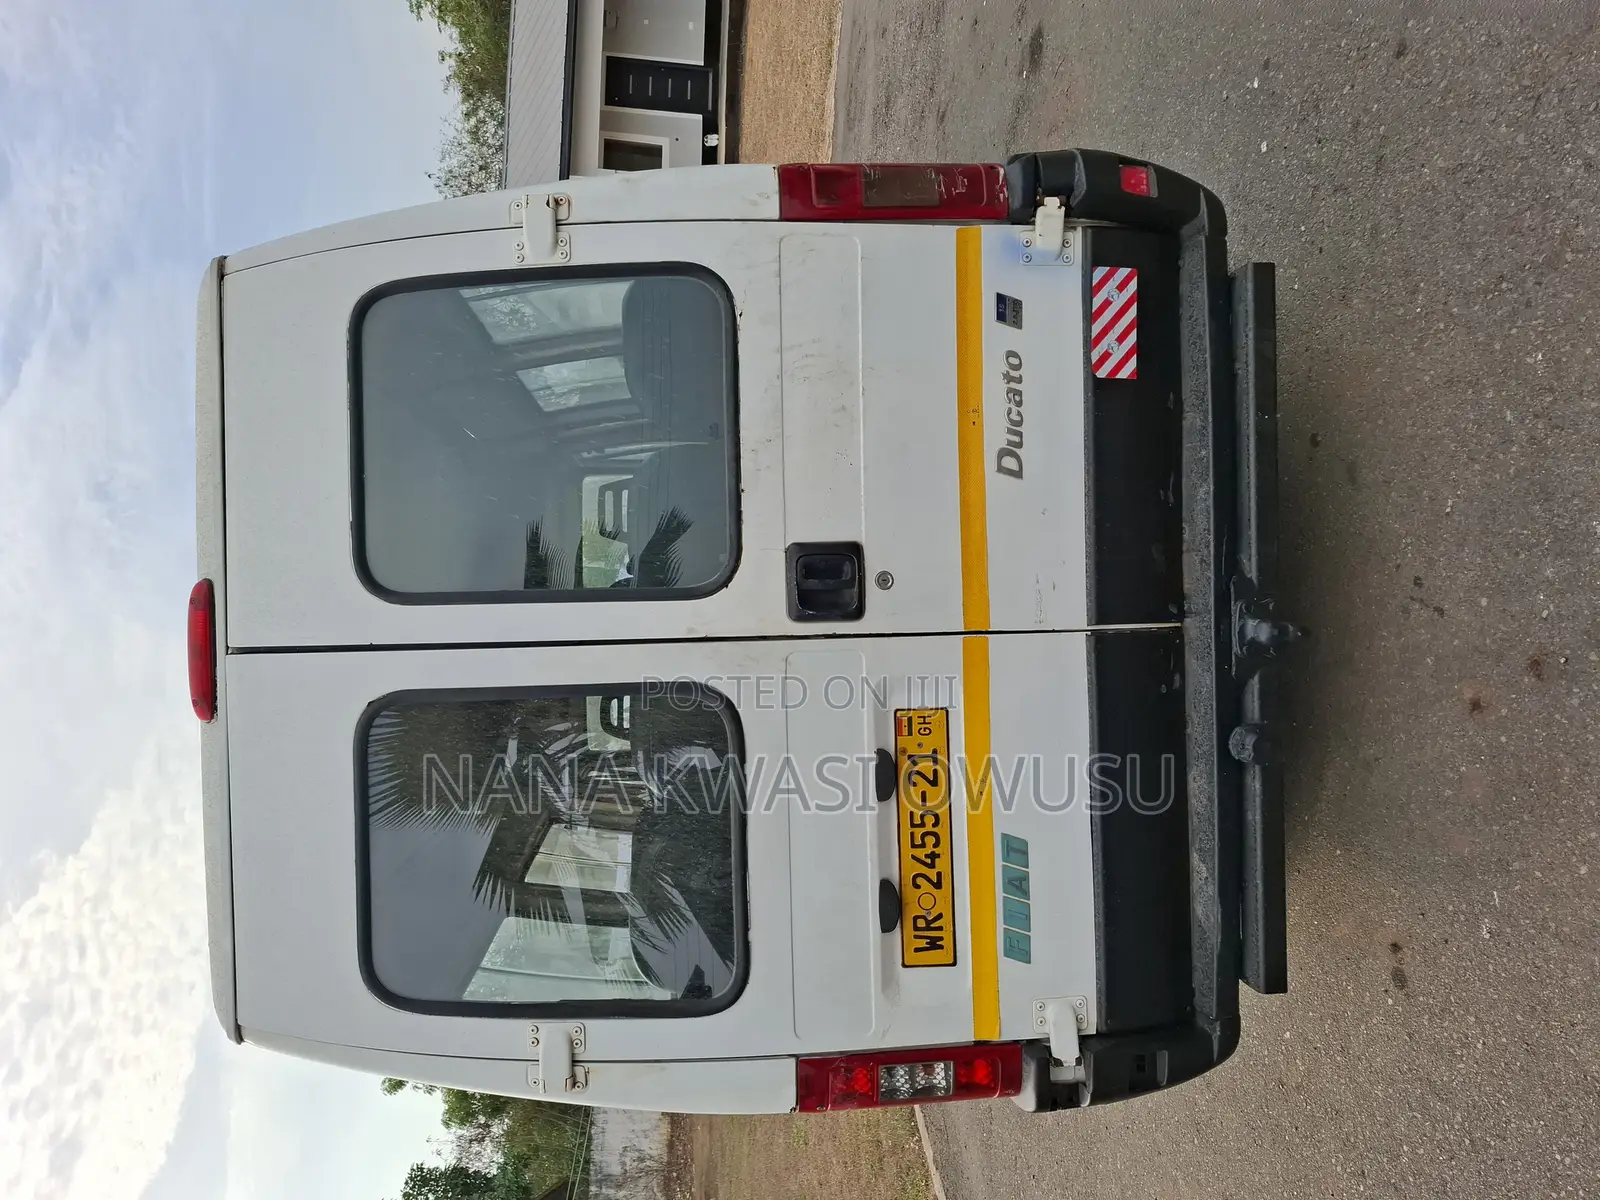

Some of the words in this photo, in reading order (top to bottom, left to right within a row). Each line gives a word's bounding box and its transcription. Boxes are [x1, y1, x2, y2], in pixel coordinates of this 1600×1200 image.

[996, 350, 1023, 480] Ducato
[917, 715, 932, 737] GH
[912, 911, 944, 953] WR
[1002, 835, 1030, 962] FIAT
